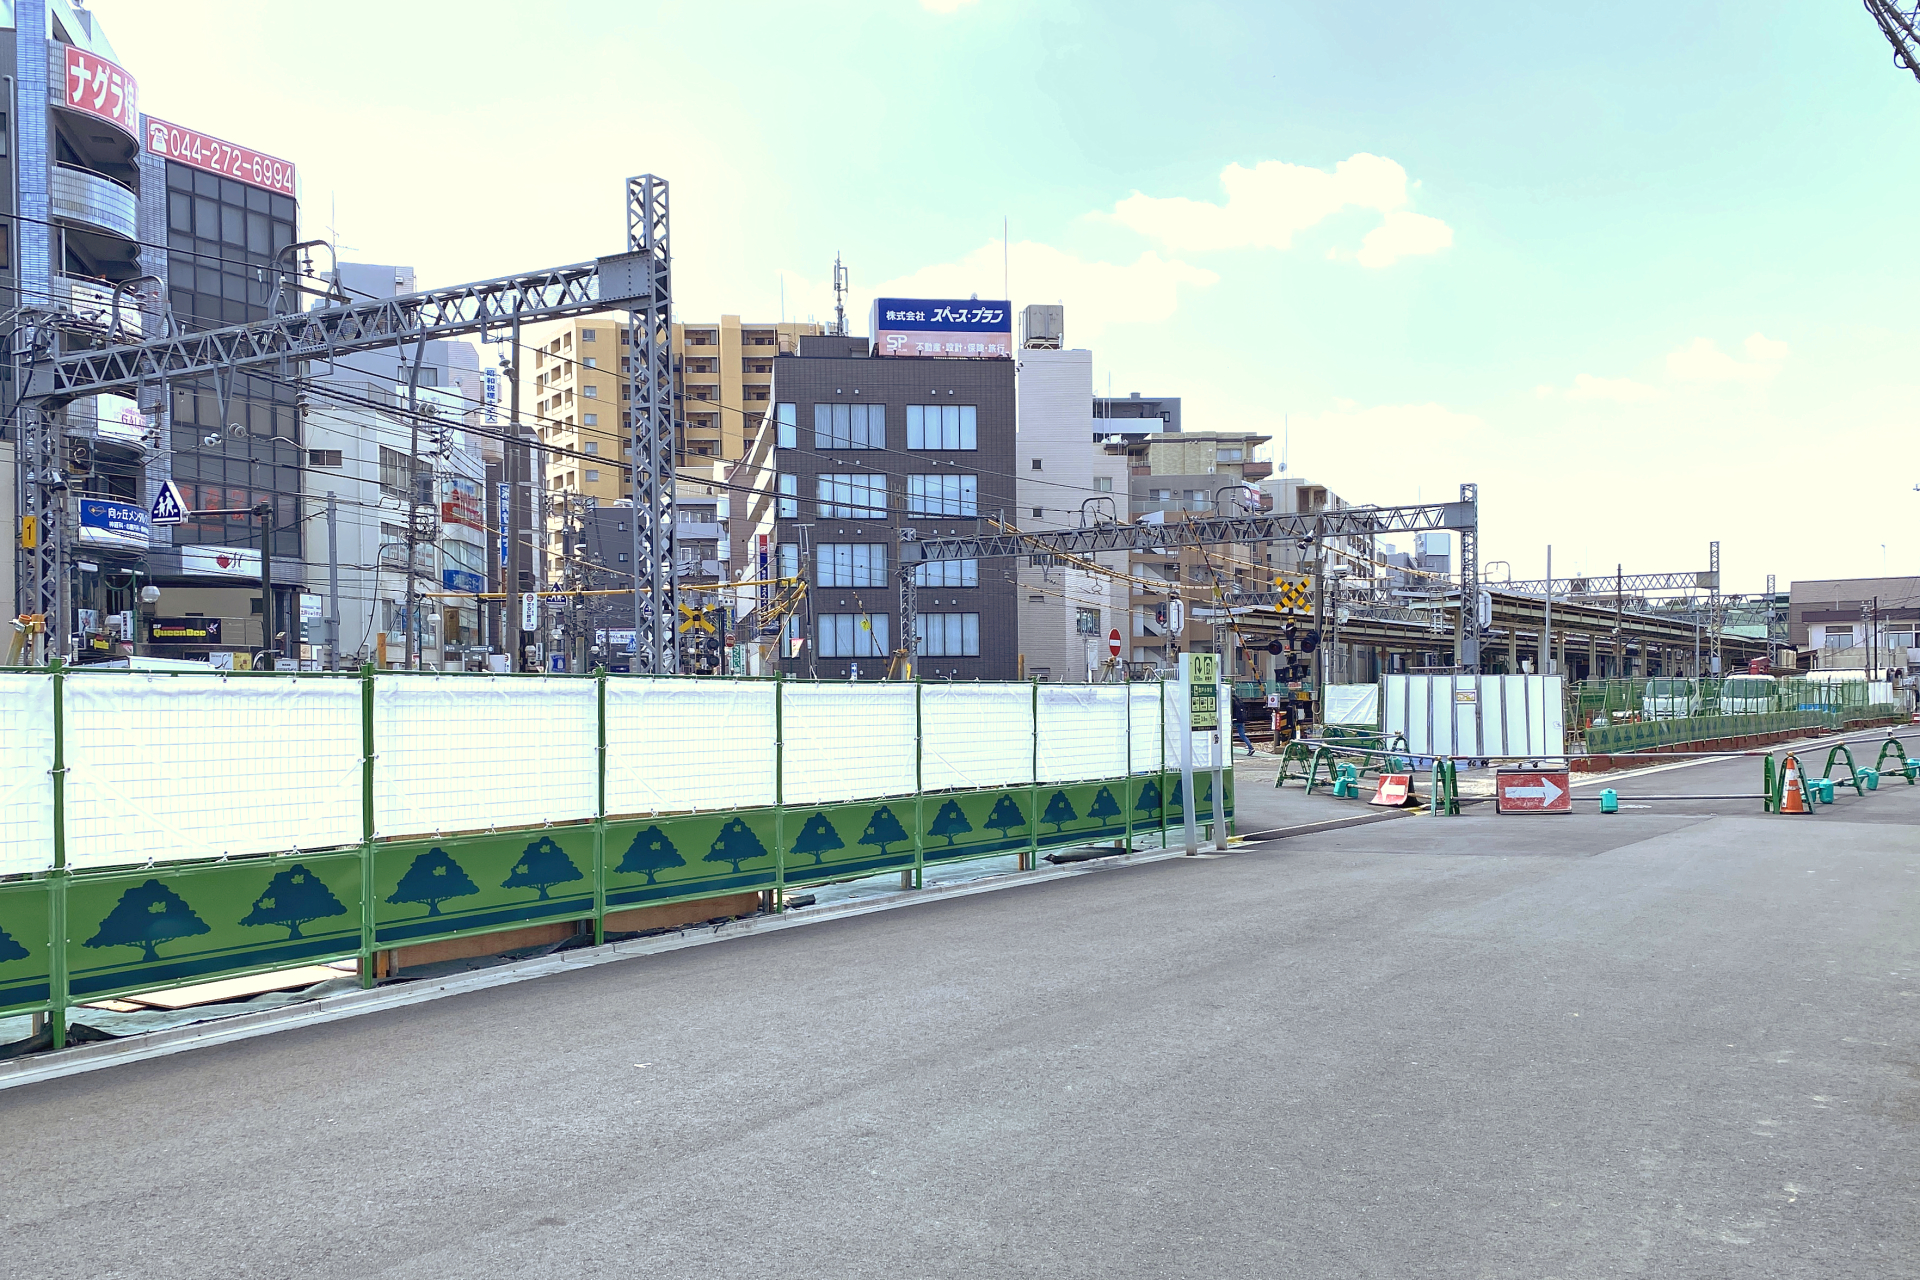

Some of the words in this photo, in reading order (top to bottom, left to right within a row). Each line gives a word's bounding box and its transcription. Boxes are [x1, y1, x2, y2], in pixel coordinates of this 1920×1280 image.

[70, 56, 138, 133] ナグラ接
[170, 129, 292, 191] 044-272-6994
[886, 310, 925, 321] 株式会社
[930, 306, 1004, 323] スペース・プラン
[107, 507, 149, 525] 向ヶ丘メンタル
[26, 523, 32, 541] 1
